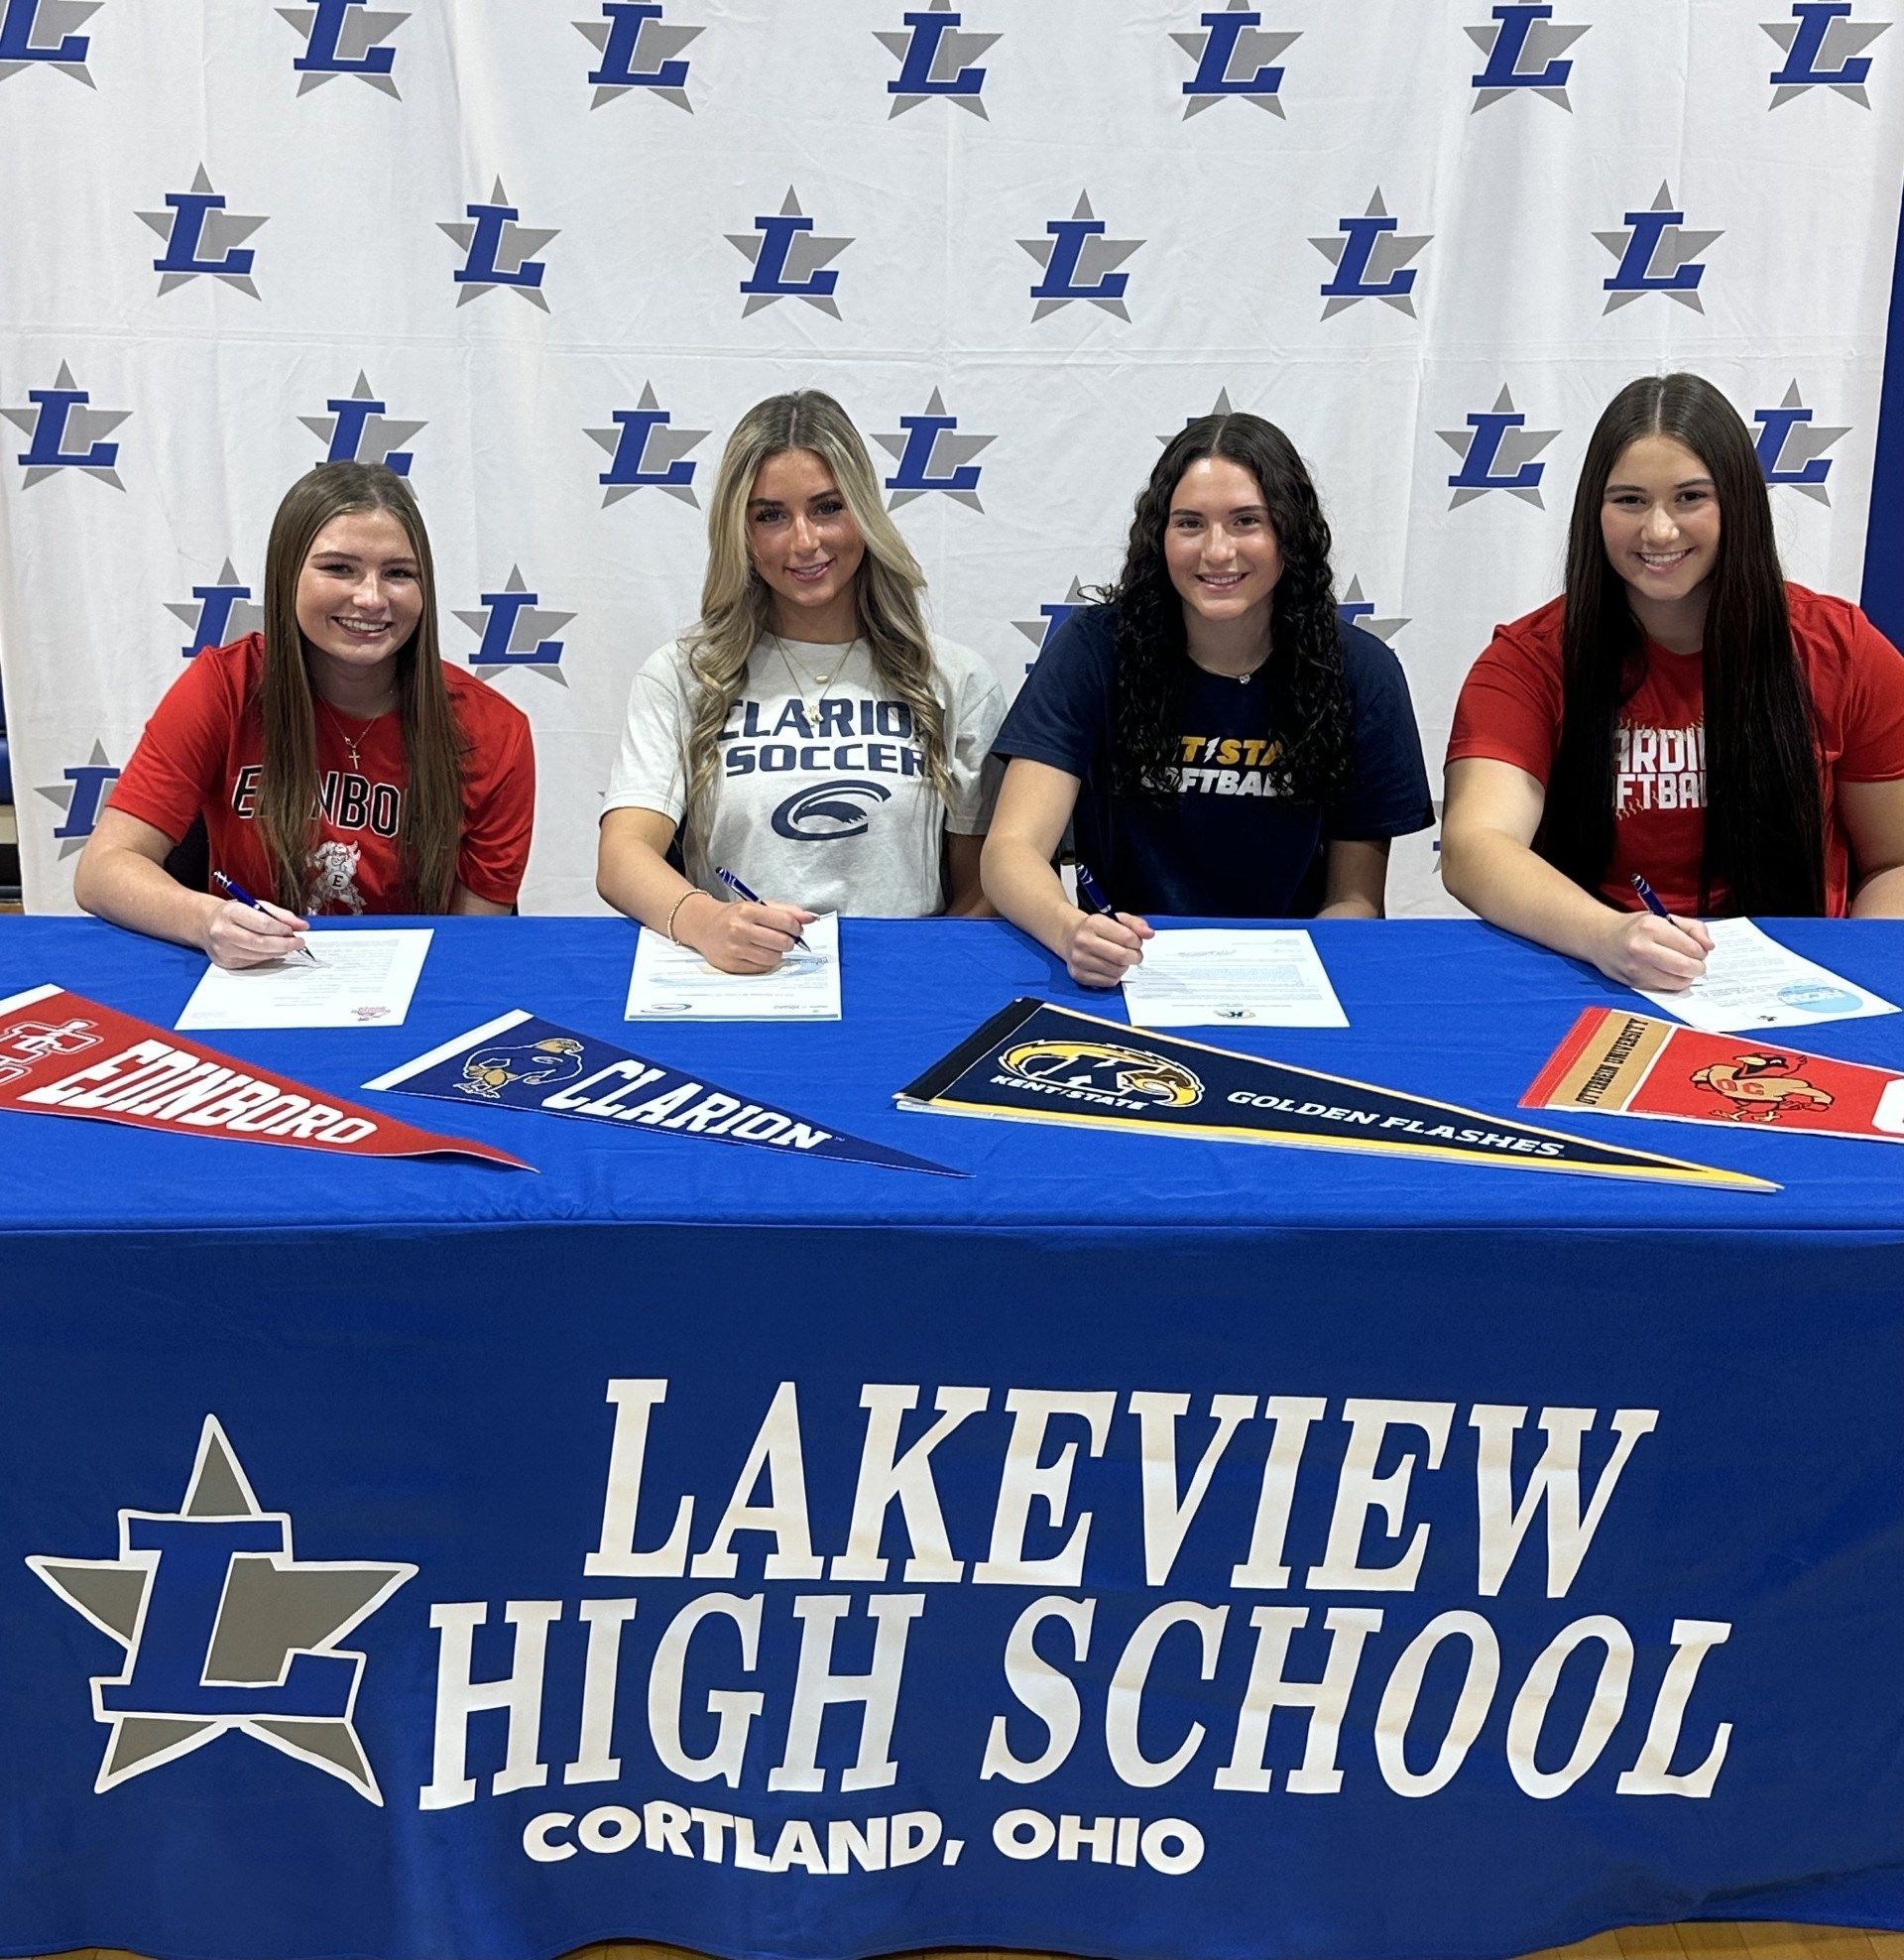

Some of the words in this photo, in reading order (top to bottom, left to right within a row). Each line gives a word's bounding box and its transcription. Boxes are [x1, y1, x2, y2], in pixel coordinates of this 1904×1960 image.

[294, 0, 396, 73] L
[588, 3, 689, 87] L
[888, 12, 987, 94] L
[1182, 12, 1284, 94] L
[1472, 5, 1573, 87] L
[1770, 2, 1872, 84] L
[154, 193, 255, 275] L
[454, 204, 545, 287] L
[740, 216, 839, 296] L
[1030, 220, 1130, 299] L
[1321, 217, 1417, 297] L
[1603, 211, 1706, 291] L
[18, 390, 119, 466] L
[599, 411, 696, 485] L
[886, 417, 982, 489] L
[1448, 414, 1544, 487] L
[469, 593, 564, 665] L
[717, 698, 937, 742] CLARIO
[726, 744, 928, 778] SOCCER
[17, 1039, 379, 1144] EDINBORO
[540, 1059, 832, 1149] CLARION
[990, 1074, 1062, 1095] KENT
[1065, 1089, 1150, 1111] STATE
[1227, 1091, 1380, 1126] GOLDEN
[1378, 1116, 1565, 1157] FLASHES
[583, 1378, 1660, 1599] LAKEVIEW
[418, 1592, 926, 1811] HIGH
[979, 1595, 1733, 1800] SCHOOL
[523, 1800, 966, 1875] CORTLAND,
[992, 1808, 1205, 1876] OHIO
